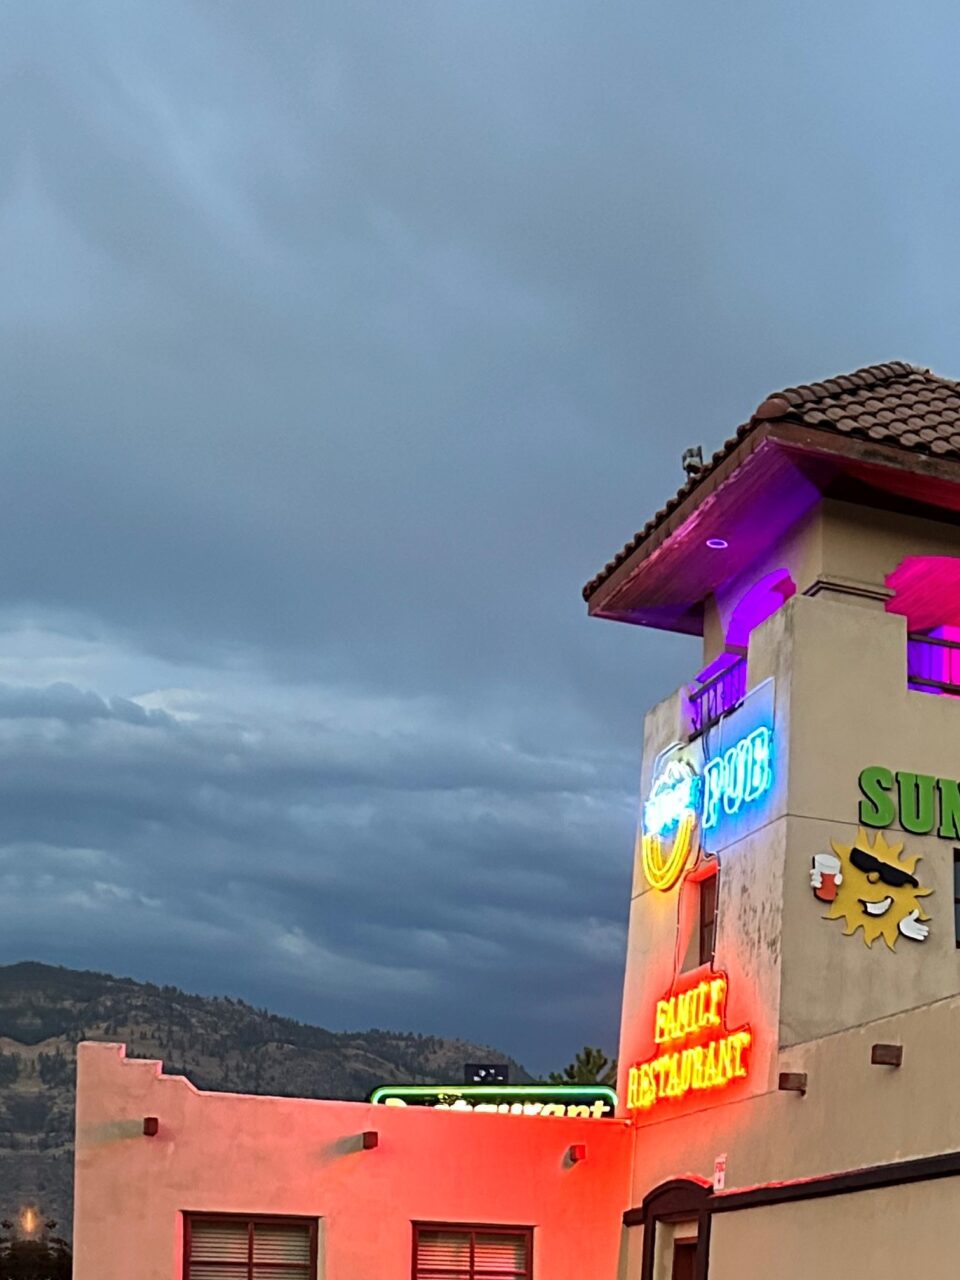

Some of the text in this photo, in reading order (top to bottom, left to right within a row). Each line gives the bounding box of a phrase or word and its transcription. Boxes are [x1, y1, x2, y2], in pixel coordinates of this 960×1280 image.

[702, 727, 771, 828] PUB
[655, 979, 725, 1043] FAMILY
[627, 1032, 751, 1109] RESTAURANT
